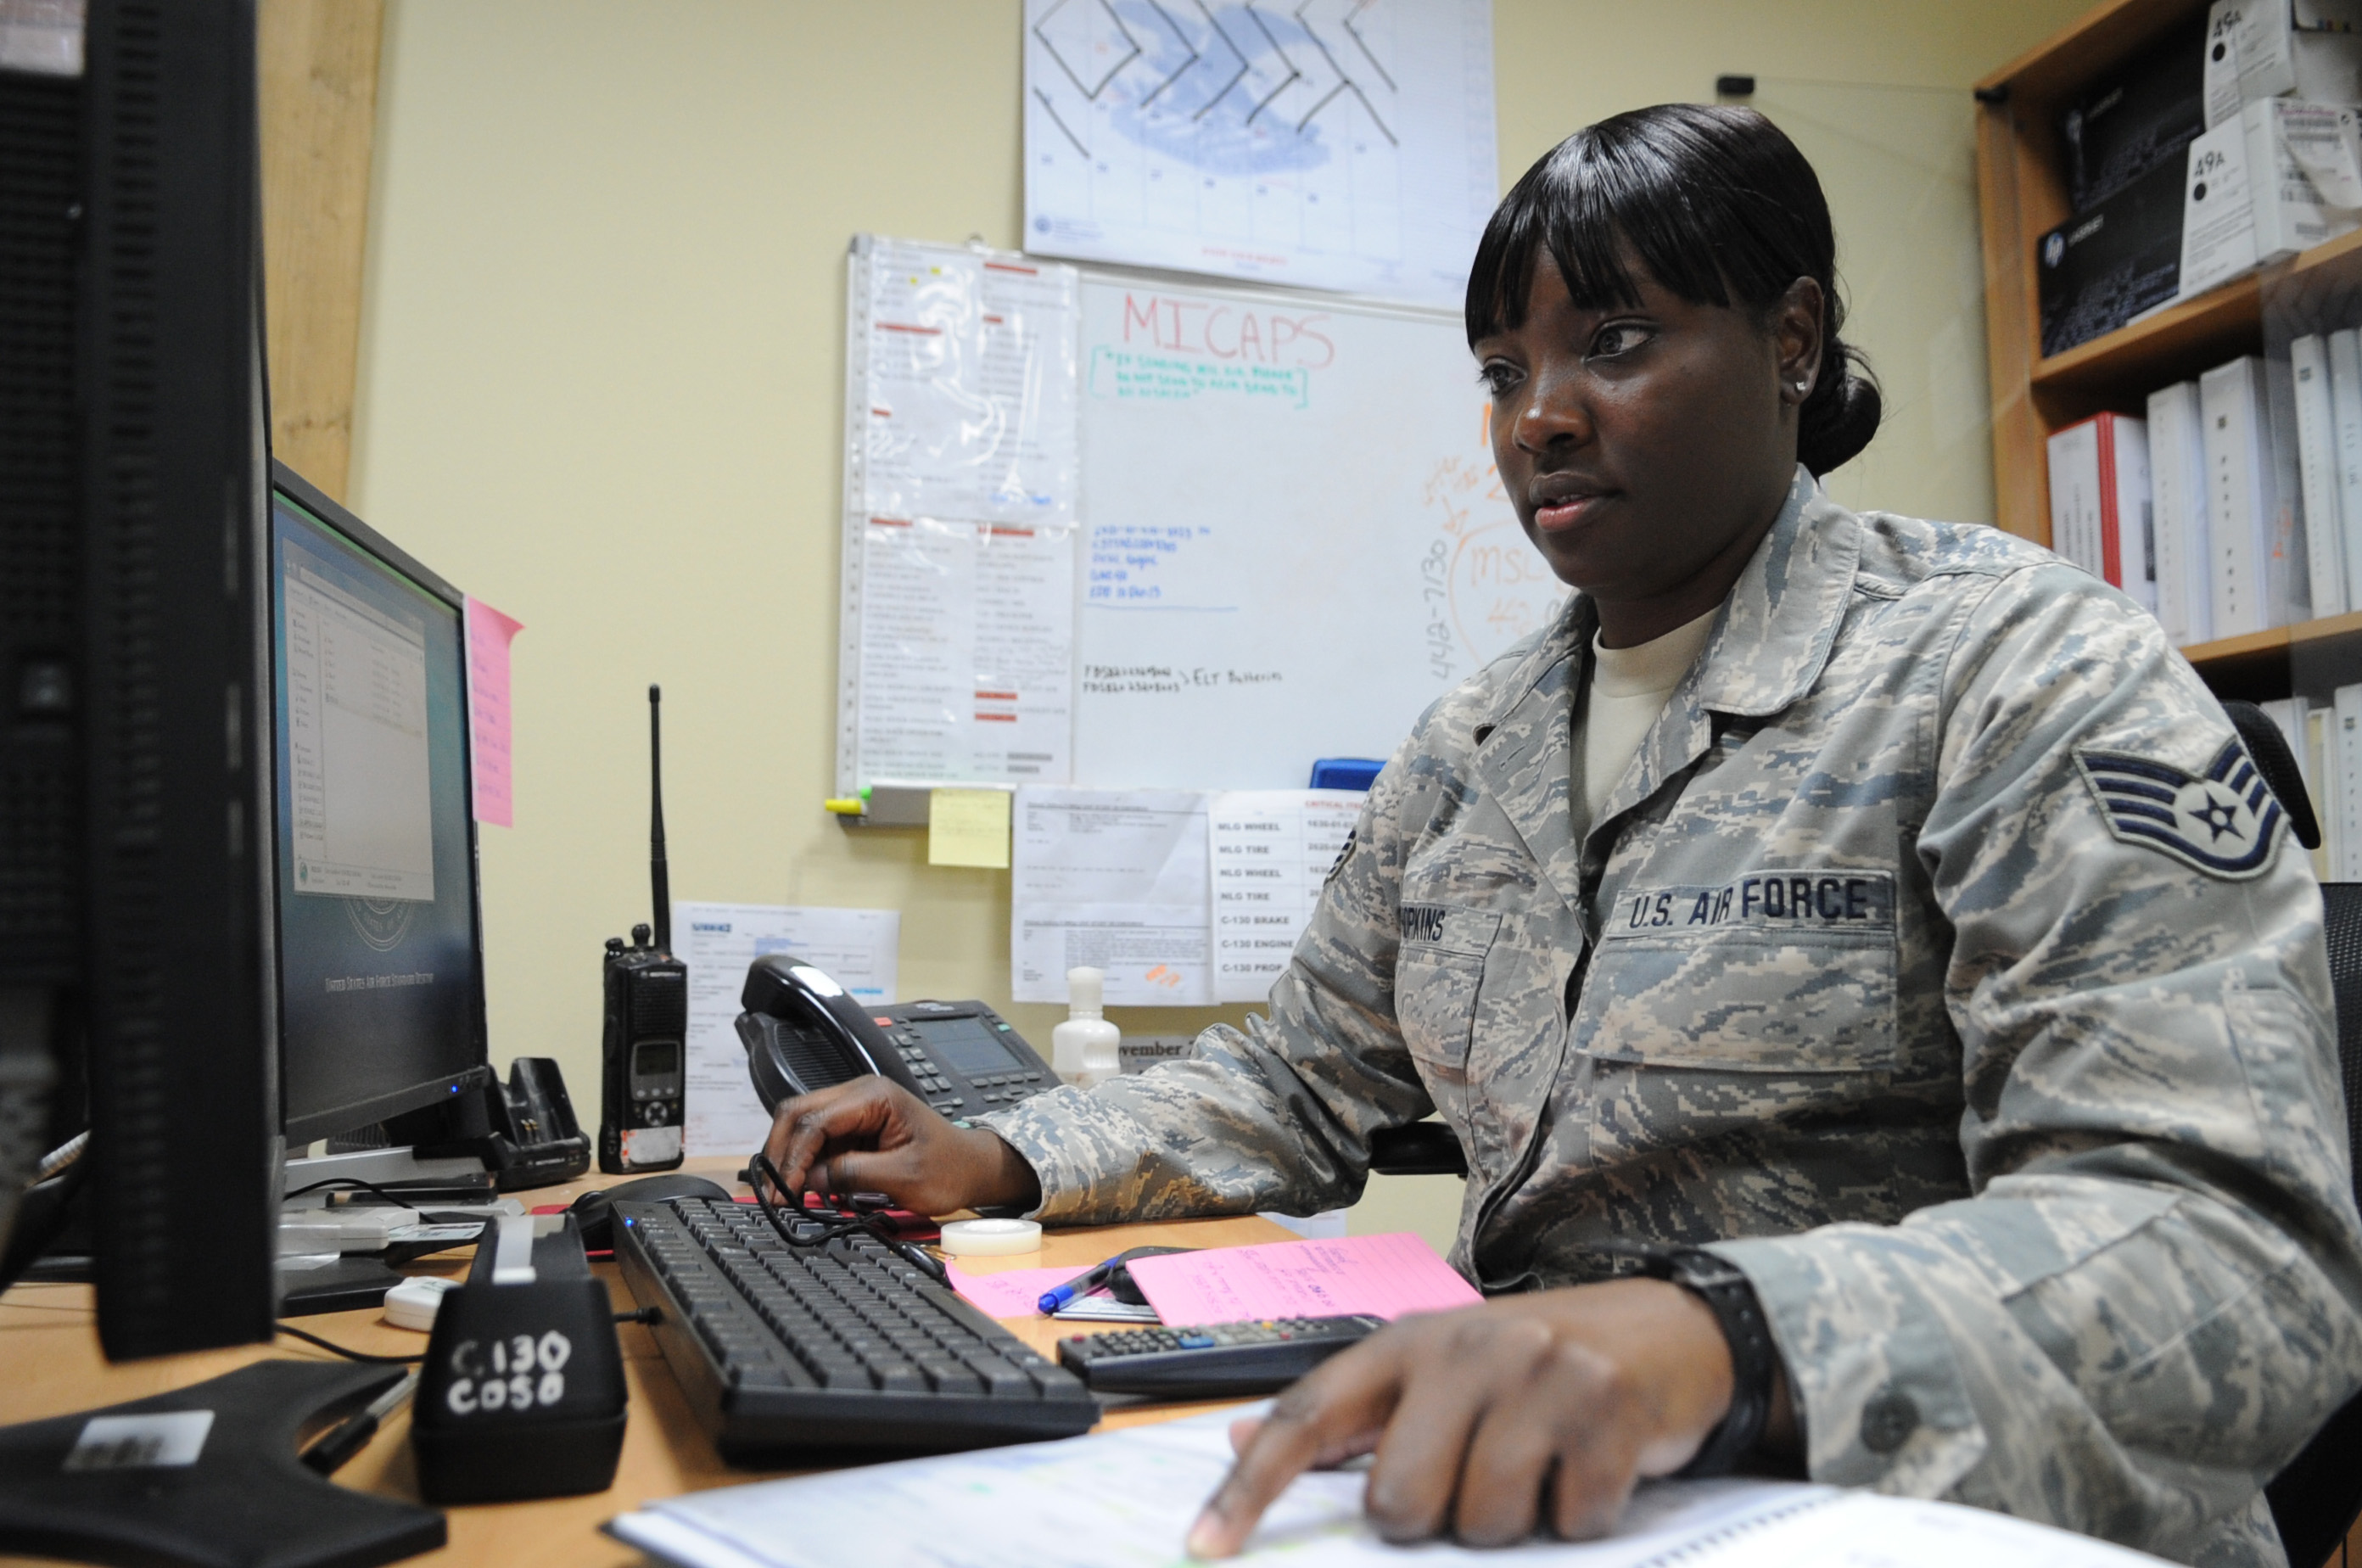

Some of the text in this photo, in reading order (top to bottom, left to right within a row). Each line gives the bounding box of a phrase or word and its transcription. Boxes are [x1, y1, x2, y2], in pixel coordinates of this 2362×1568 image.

[2194, 151, 2225, 176] 49A
[1123, 293, 1335, 369] MICAPS
[1245, 823, 1282, 832] WHEEL
[1219, 846, 1242, 854] MLG
[1246, 846, 1270, 854] TIRE
[1220, 869, 1242, 877] NLG
[1245, 869, 1283, 878] WHEEL
[1220, 892, 1270, 900] NLG TIRE
[1629, 877, 1868, 929] U.S. AIR FORCE
[1221, 916, 1290, 925] C-130 BRAKE
[1221, 939, 1294, 949] C-130 ENGINE
[1222, 963, 1283, 972] C-130 PROP
[1119, 1040, 1183, 1056] vember
